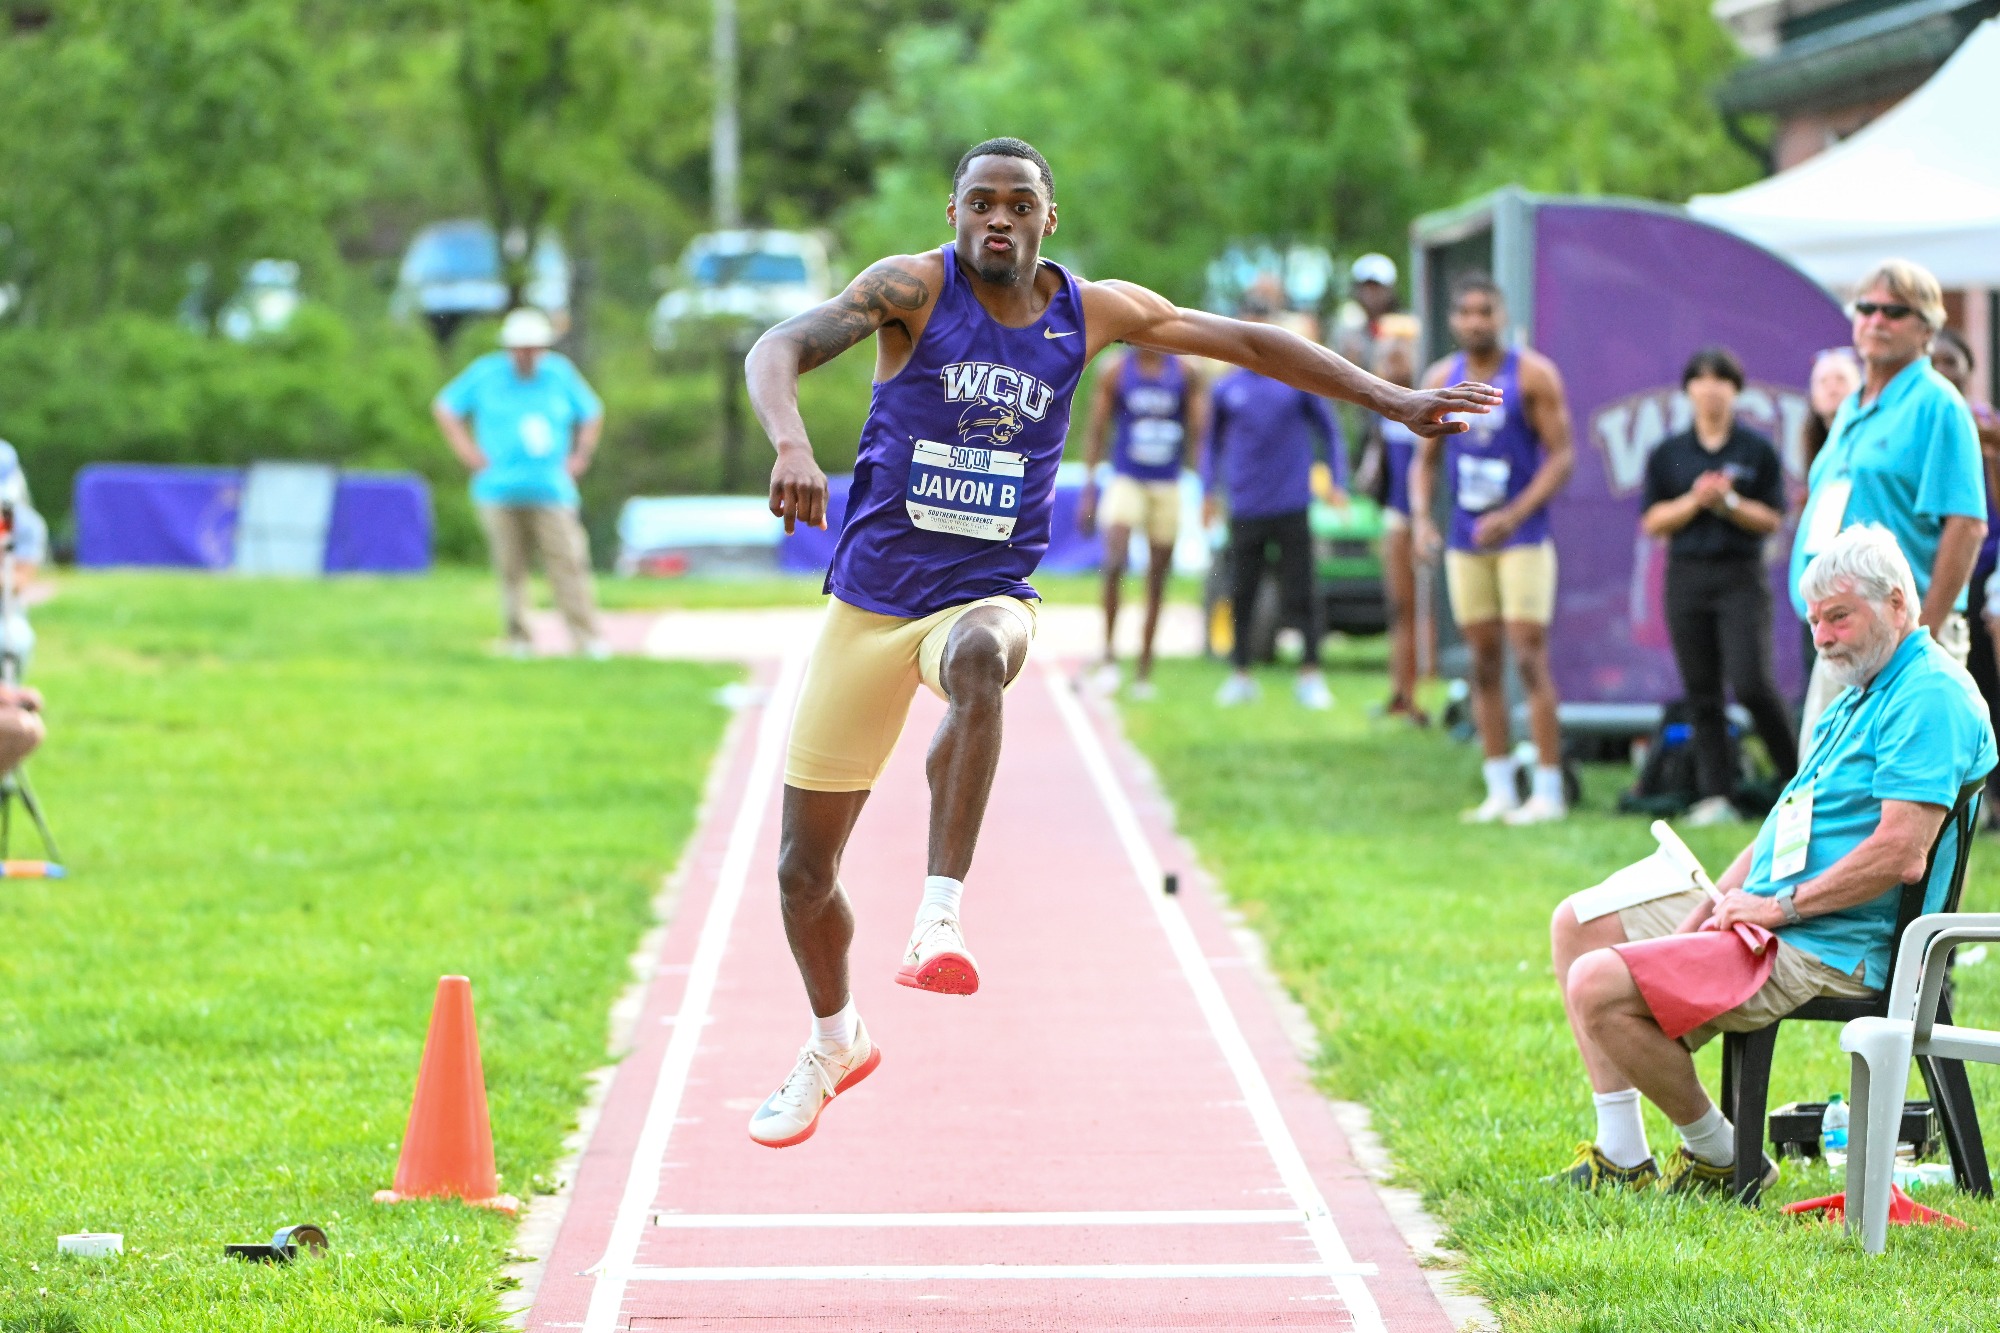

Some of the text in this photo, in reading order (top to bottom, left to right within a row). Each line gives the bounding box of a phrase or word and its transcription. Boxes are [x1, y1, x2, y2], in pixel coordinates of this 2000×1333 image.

[940, 361, 1054, 422] WCU
[912, 473, 1016, 509] JAVON B
[927, 509, 958, 520] SOUTHERN
[958, 514, 994, 525] CONFERENCE
